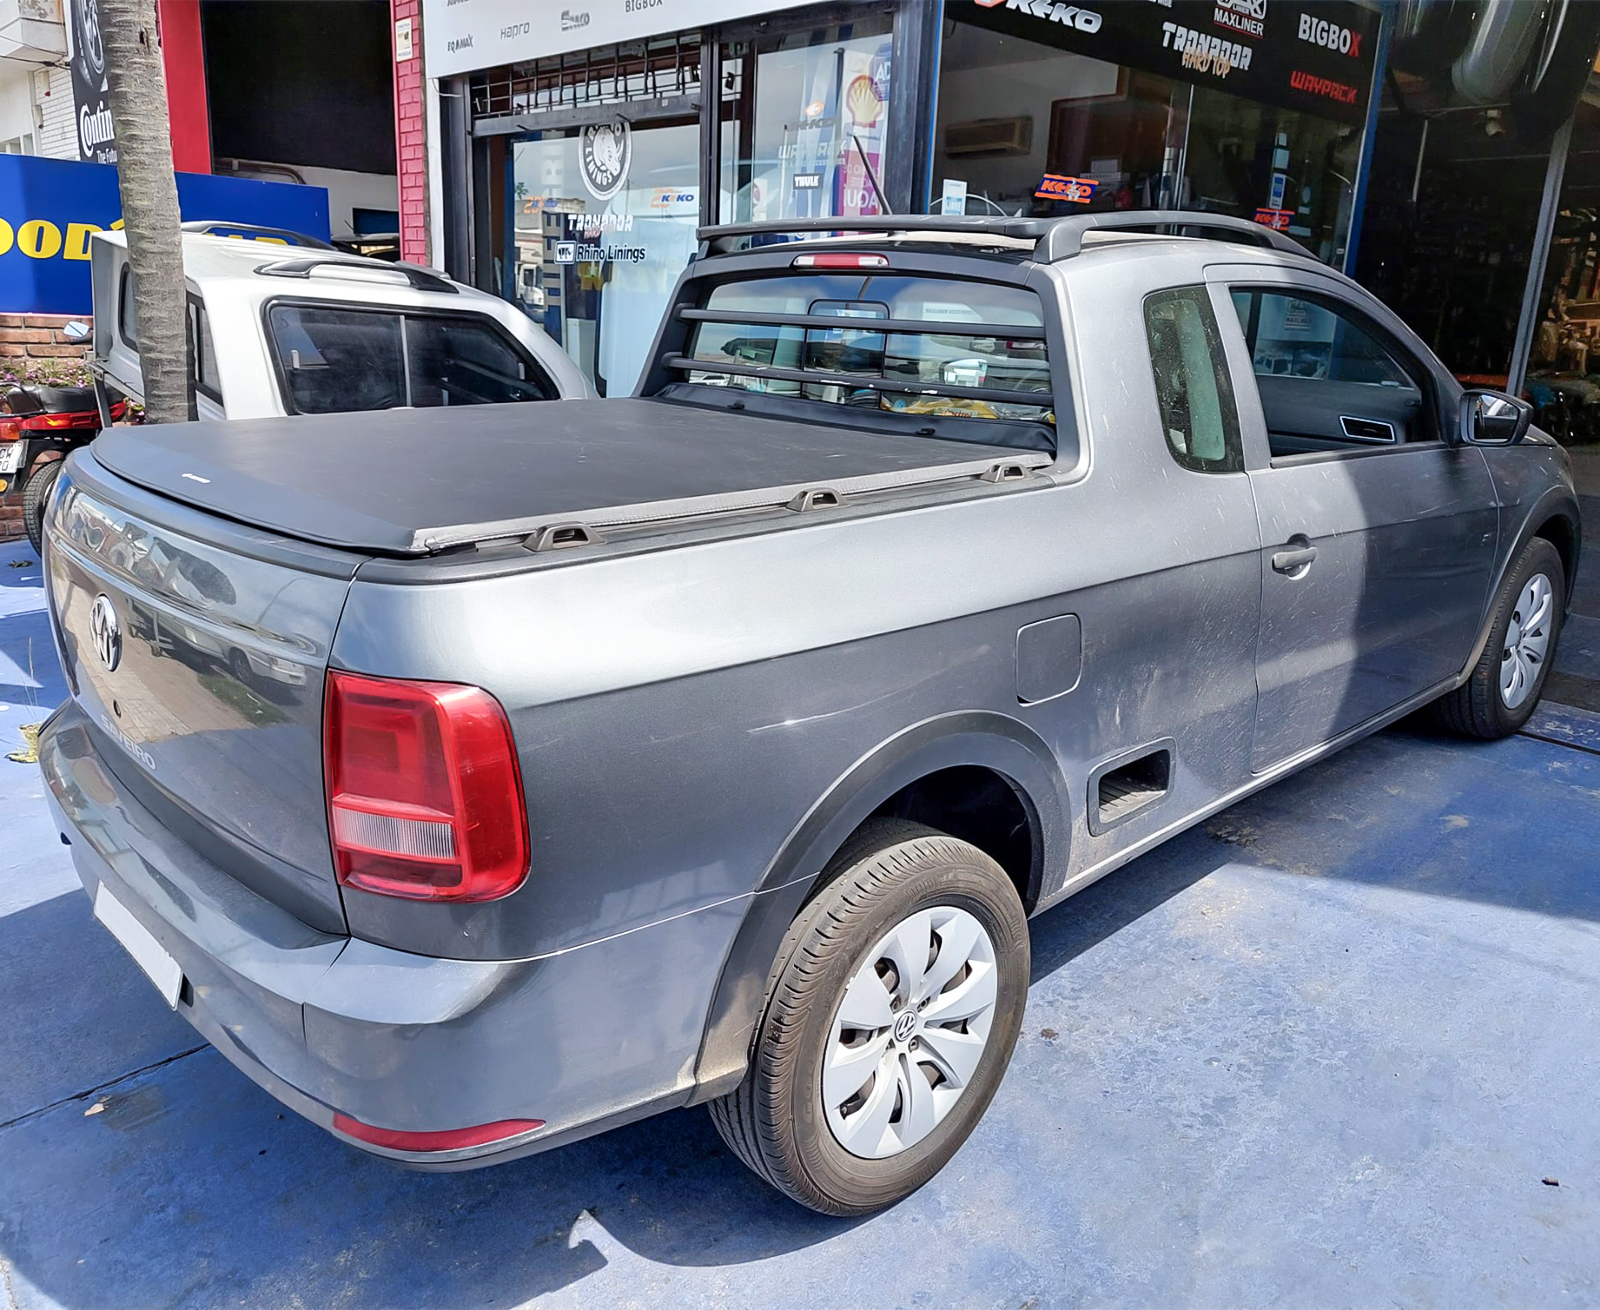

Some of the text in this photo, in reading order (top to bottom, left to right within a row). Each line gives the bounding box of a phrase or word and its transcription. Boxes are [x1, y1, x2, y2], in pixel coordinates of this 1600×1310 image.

[1213, 7, 1264, 36] MAXLINER
[1298, 13, 1363, 58] BIGBOX
[1181, 49, 1231, 79] HARD TOP
[1290, 70, 1358, 104] WAYPACK
[585, 147, 613, 186] LININGS
[794, 175, 820, 187] THULE
[576, 244, 646, 264] Rhino Linings
[100, 714, 156, 770] SAVEIRO
